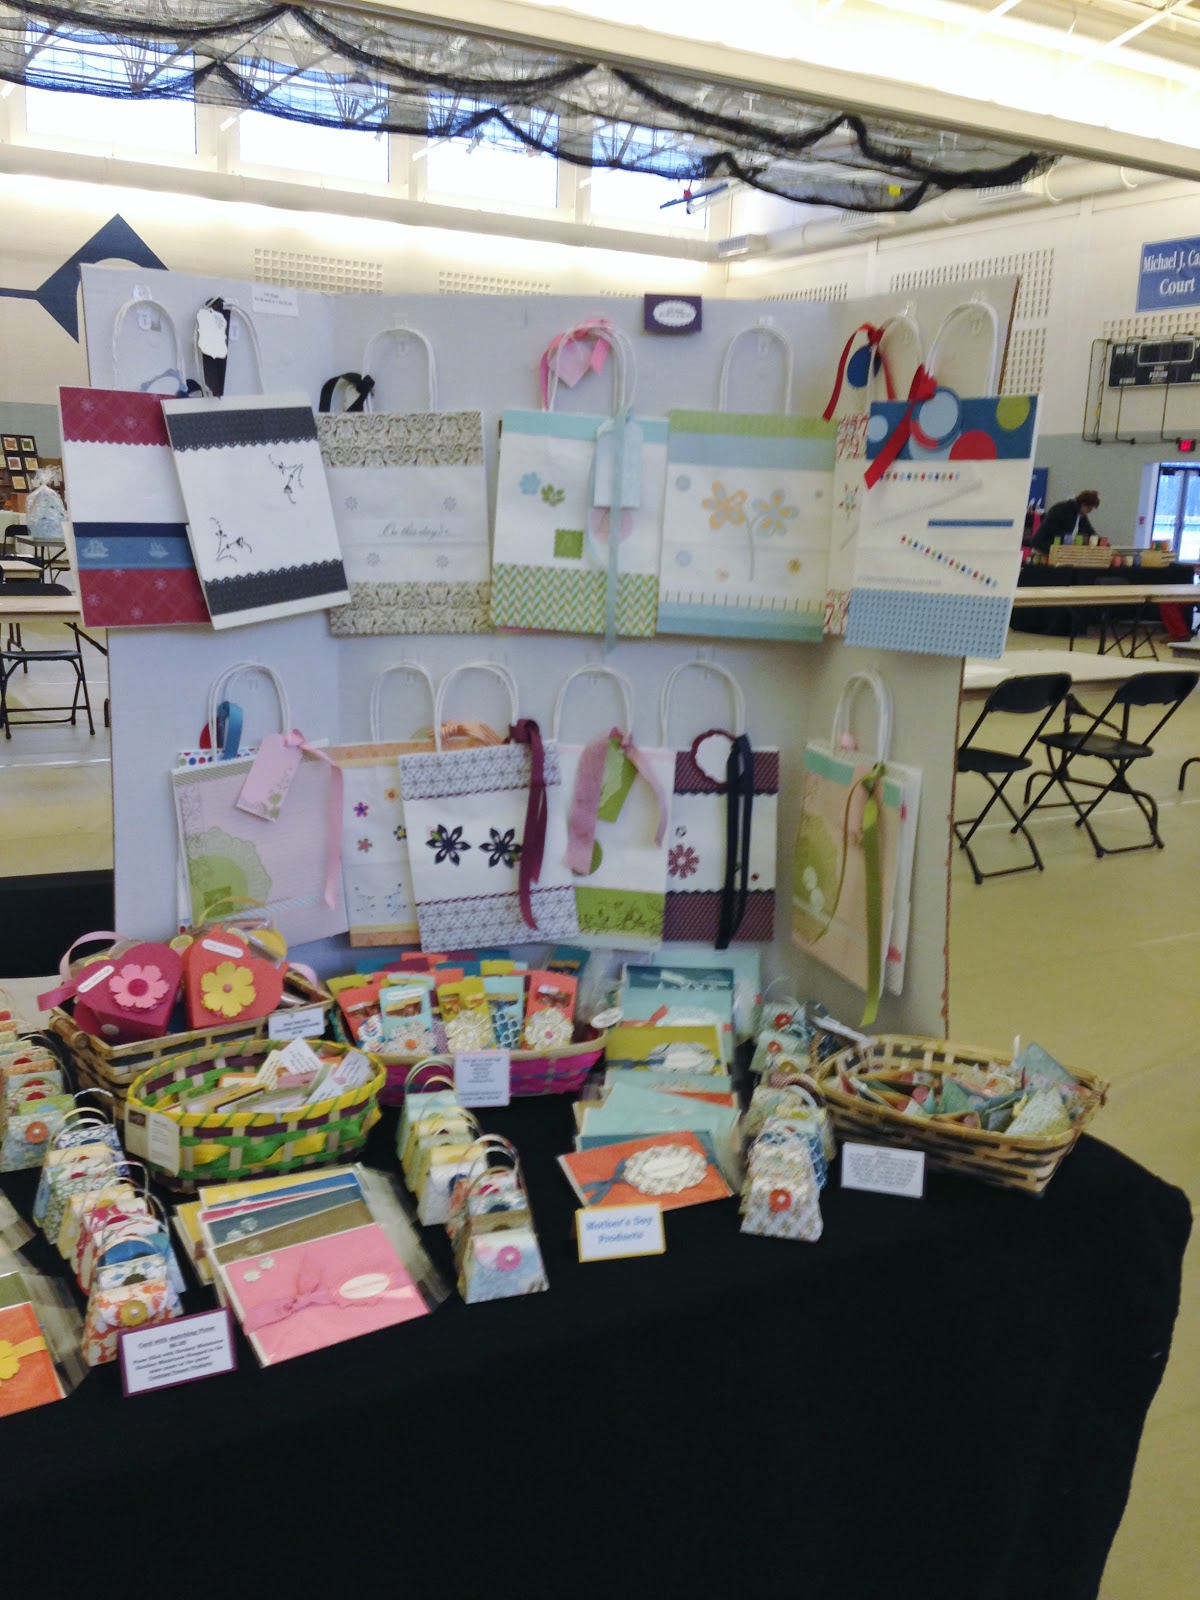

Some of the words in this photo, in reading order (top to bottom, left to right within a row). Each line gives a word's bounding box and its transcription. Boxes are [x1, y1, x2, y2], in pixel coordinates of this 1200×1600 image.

[1143, 250, 1177, 272] Michael
[1176, 251, 1186, 273] J.
[1188, 249, 1200, 267] Ca
[1159, 277, 1196, 295] Court
[401, 520, 417, 537] this
